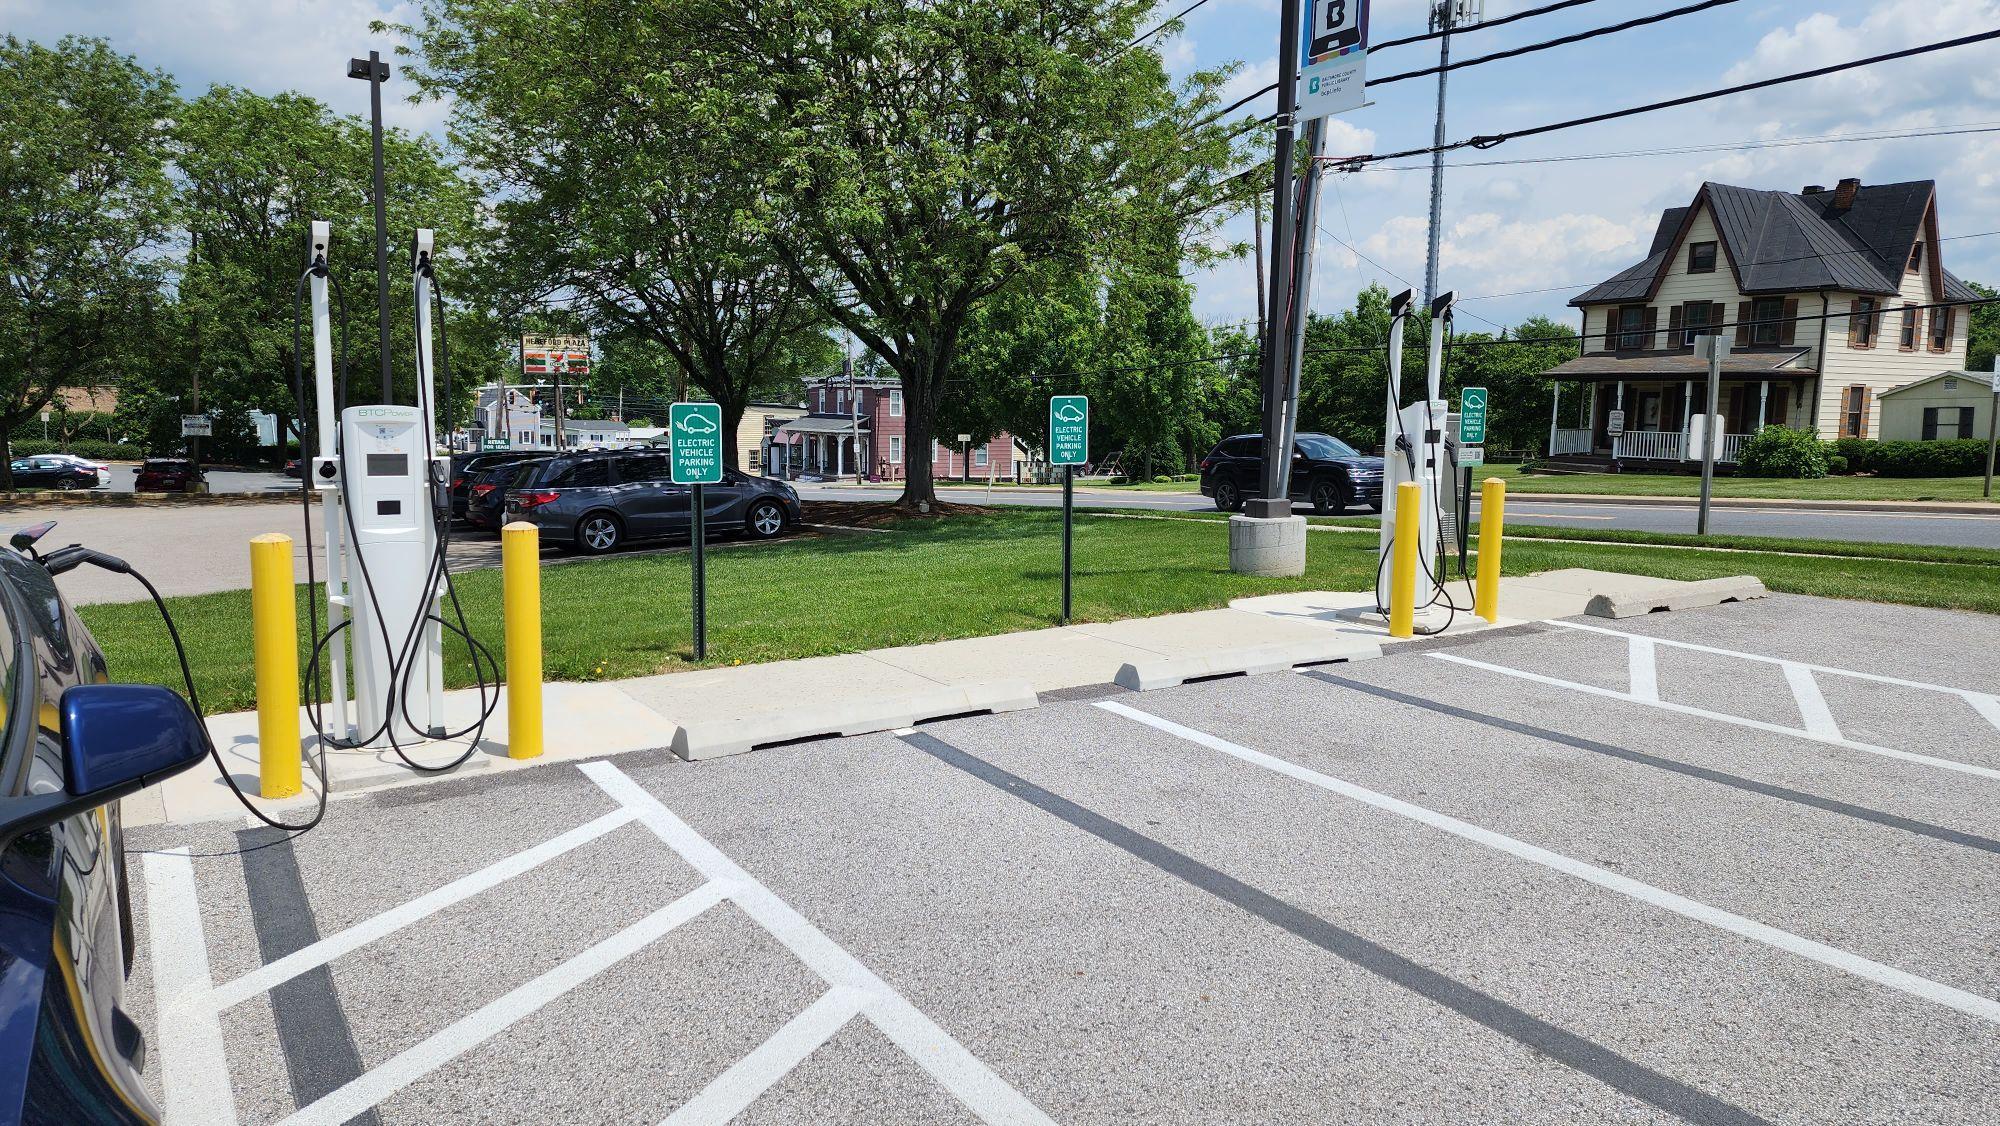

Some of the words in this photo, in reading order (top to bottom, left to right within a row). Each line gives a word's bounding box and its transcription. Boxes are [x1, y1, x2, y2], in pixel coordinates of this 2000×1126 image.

[1322, 73, 1341, 82] BALTIMORE
[1055, 426, 1083, 434] ELECTRIC
[1056, 434, 1082, 442] VEHICLE
[677, 439, 715, 447] ELECTRIC
[679, 449, 714, 457] VEHICLE
[679, 458, 715, 467] PARKING
[685, 468, 708, 476] ONLY
